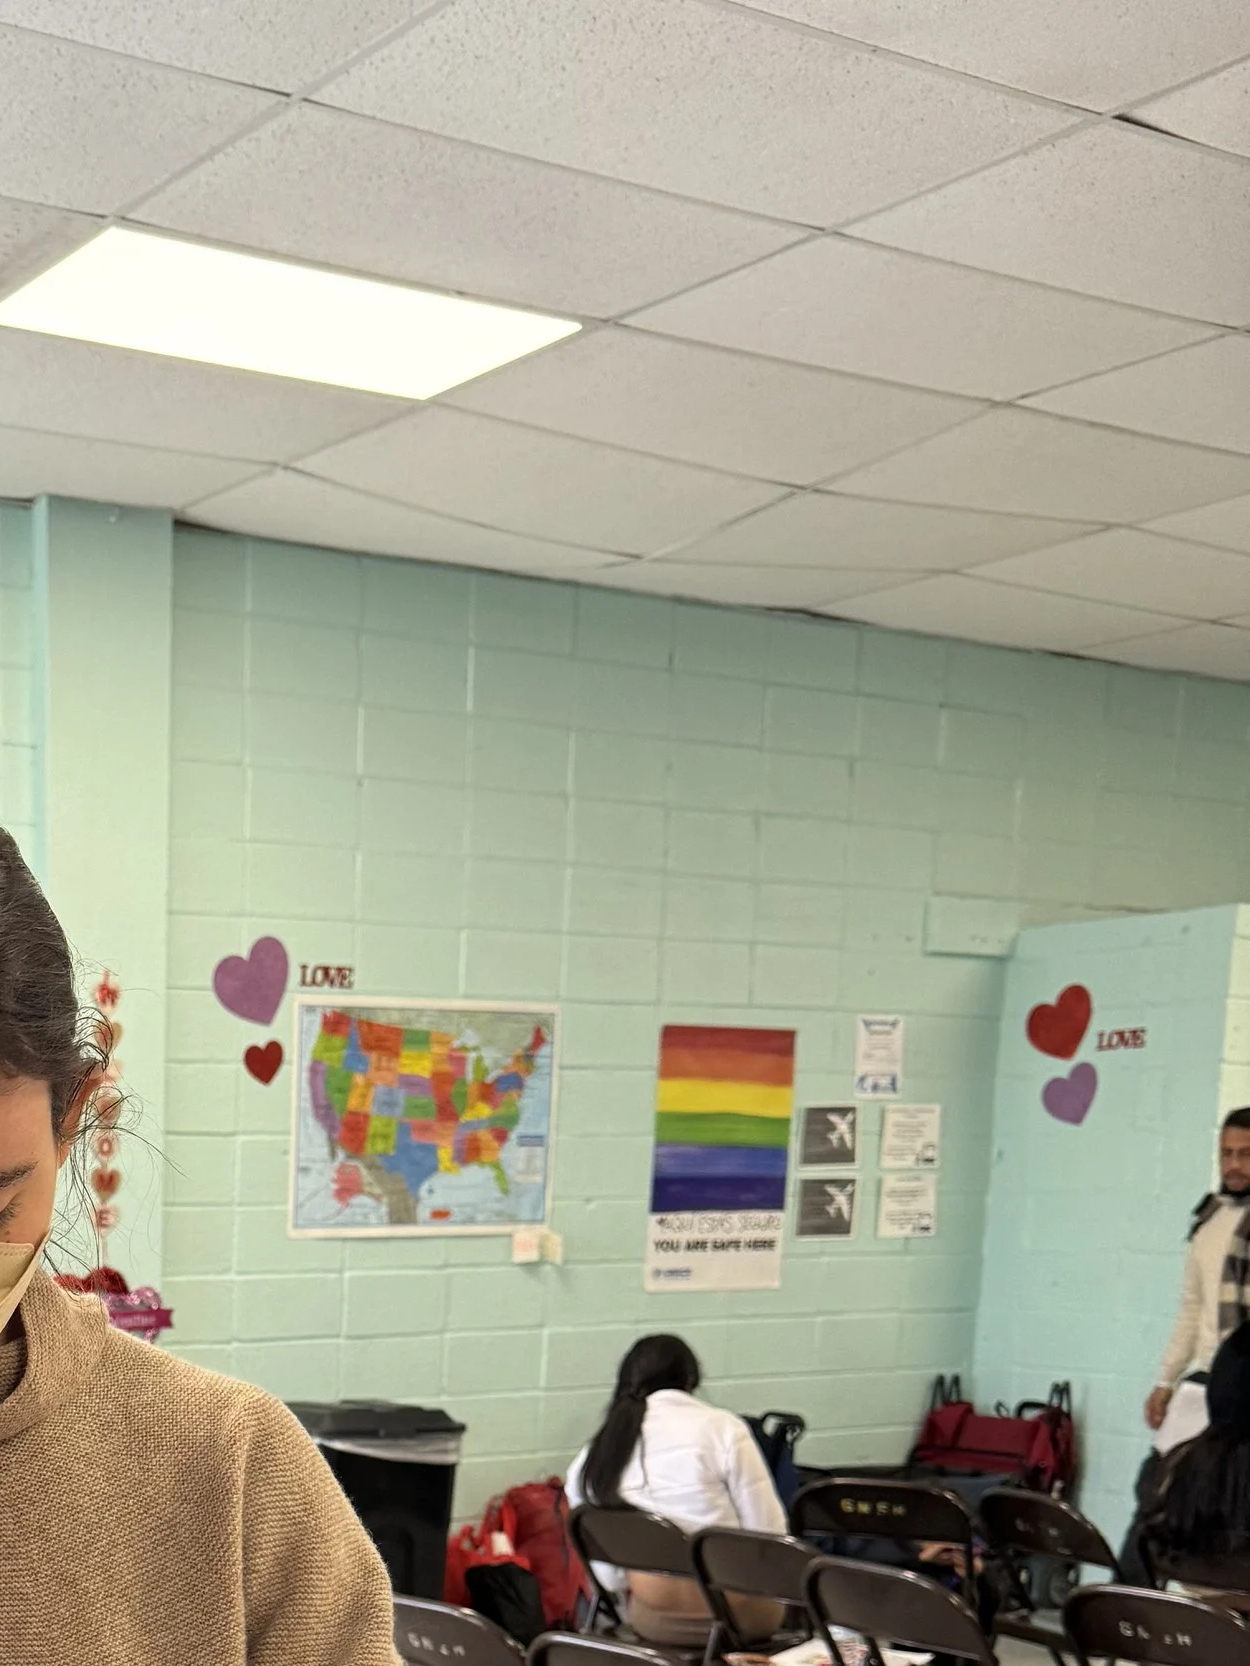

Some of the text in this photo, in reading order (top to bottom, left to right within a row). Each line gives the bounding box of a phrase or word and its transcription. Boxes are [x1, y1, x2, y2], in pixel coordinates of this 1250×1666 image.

[298, 964, 354, 989] LOVE
[1096, 1026, 1147, 1052] LOVE
[653, 1239, 680, 1252] YOU
[683, 1239, 708, 1252] ARE
